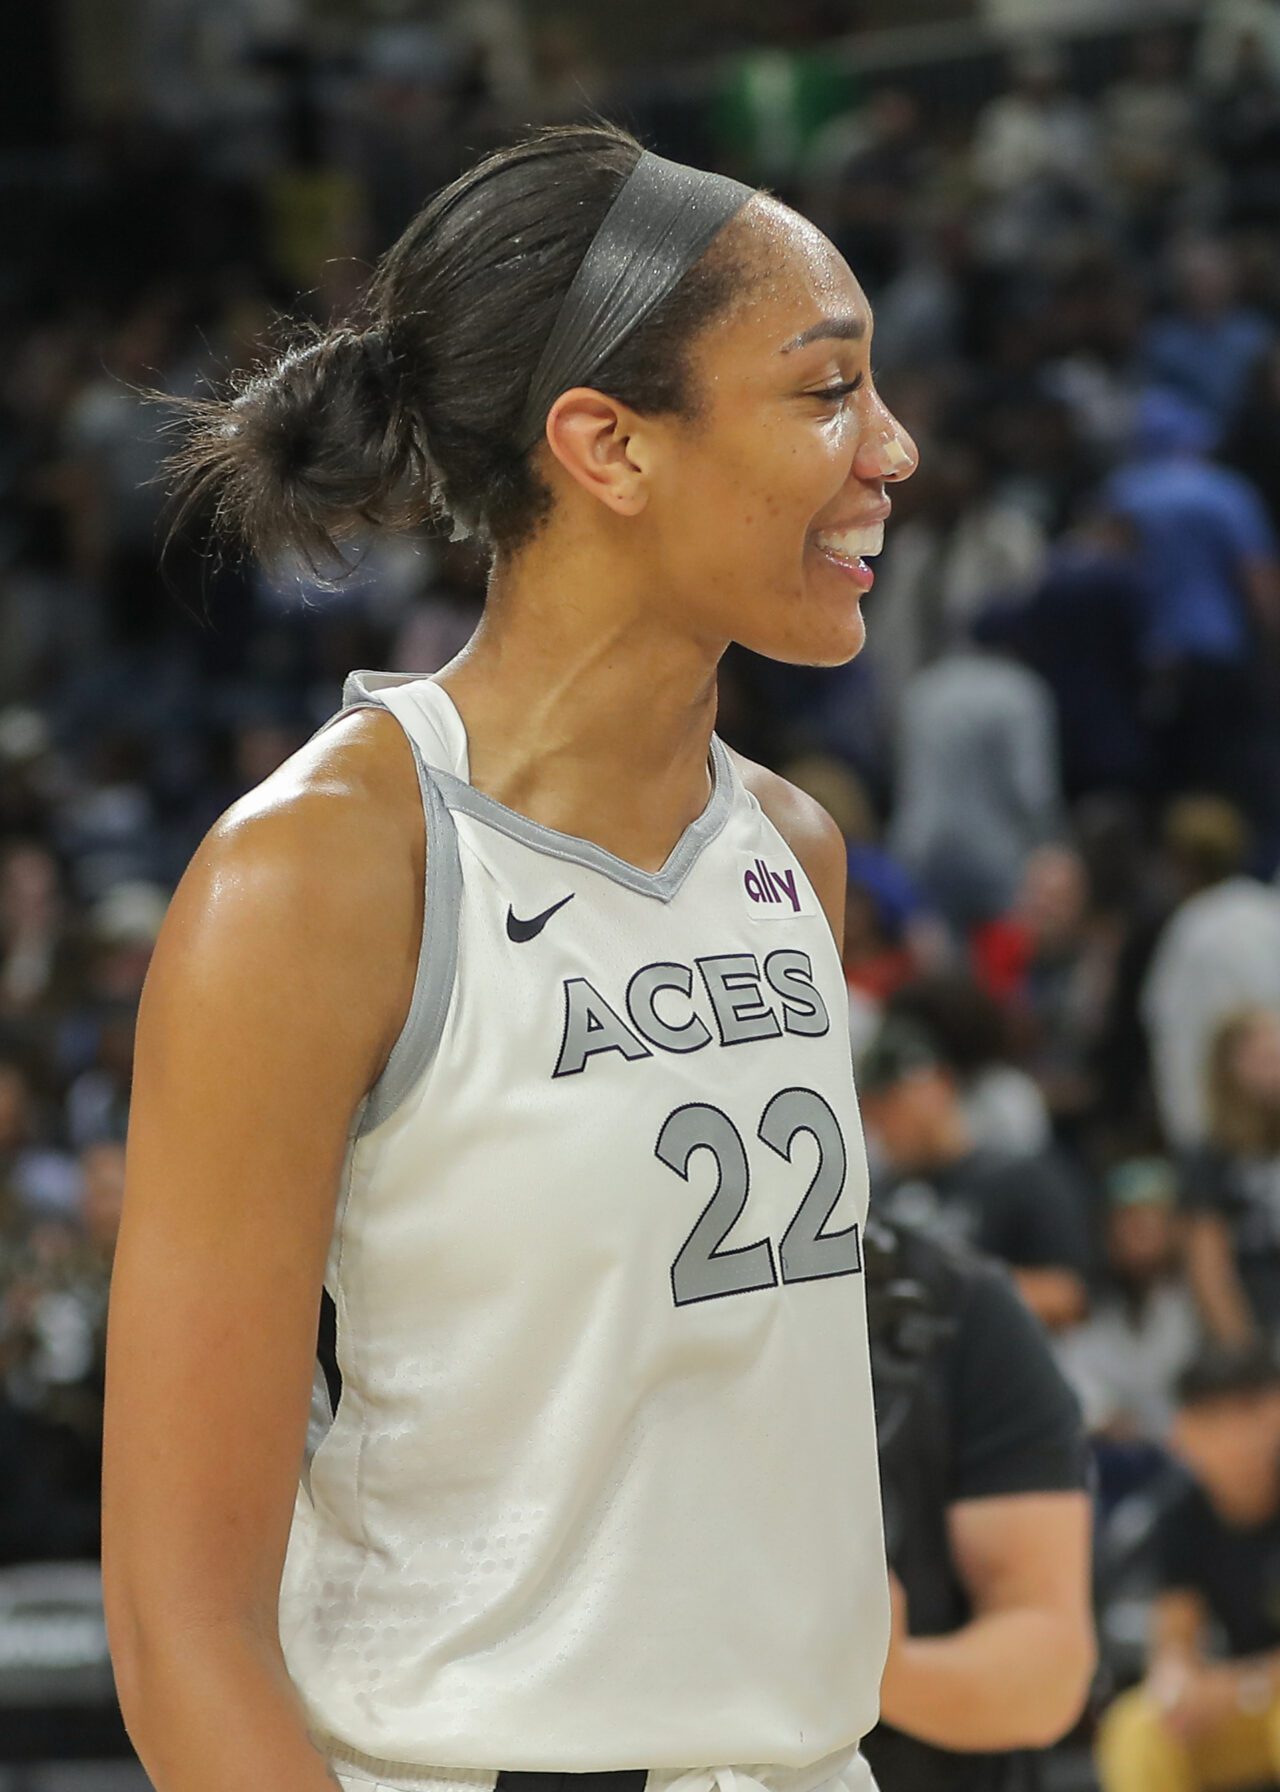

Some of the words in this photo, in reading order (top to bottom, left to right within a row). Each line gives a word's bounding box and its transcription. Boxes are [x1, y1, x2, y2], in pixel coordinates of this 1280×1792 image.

[744, 859, 801, 912] ally
[551, 949, 830, 1079] ACES
[655, 1086, 862, 1307] 22
